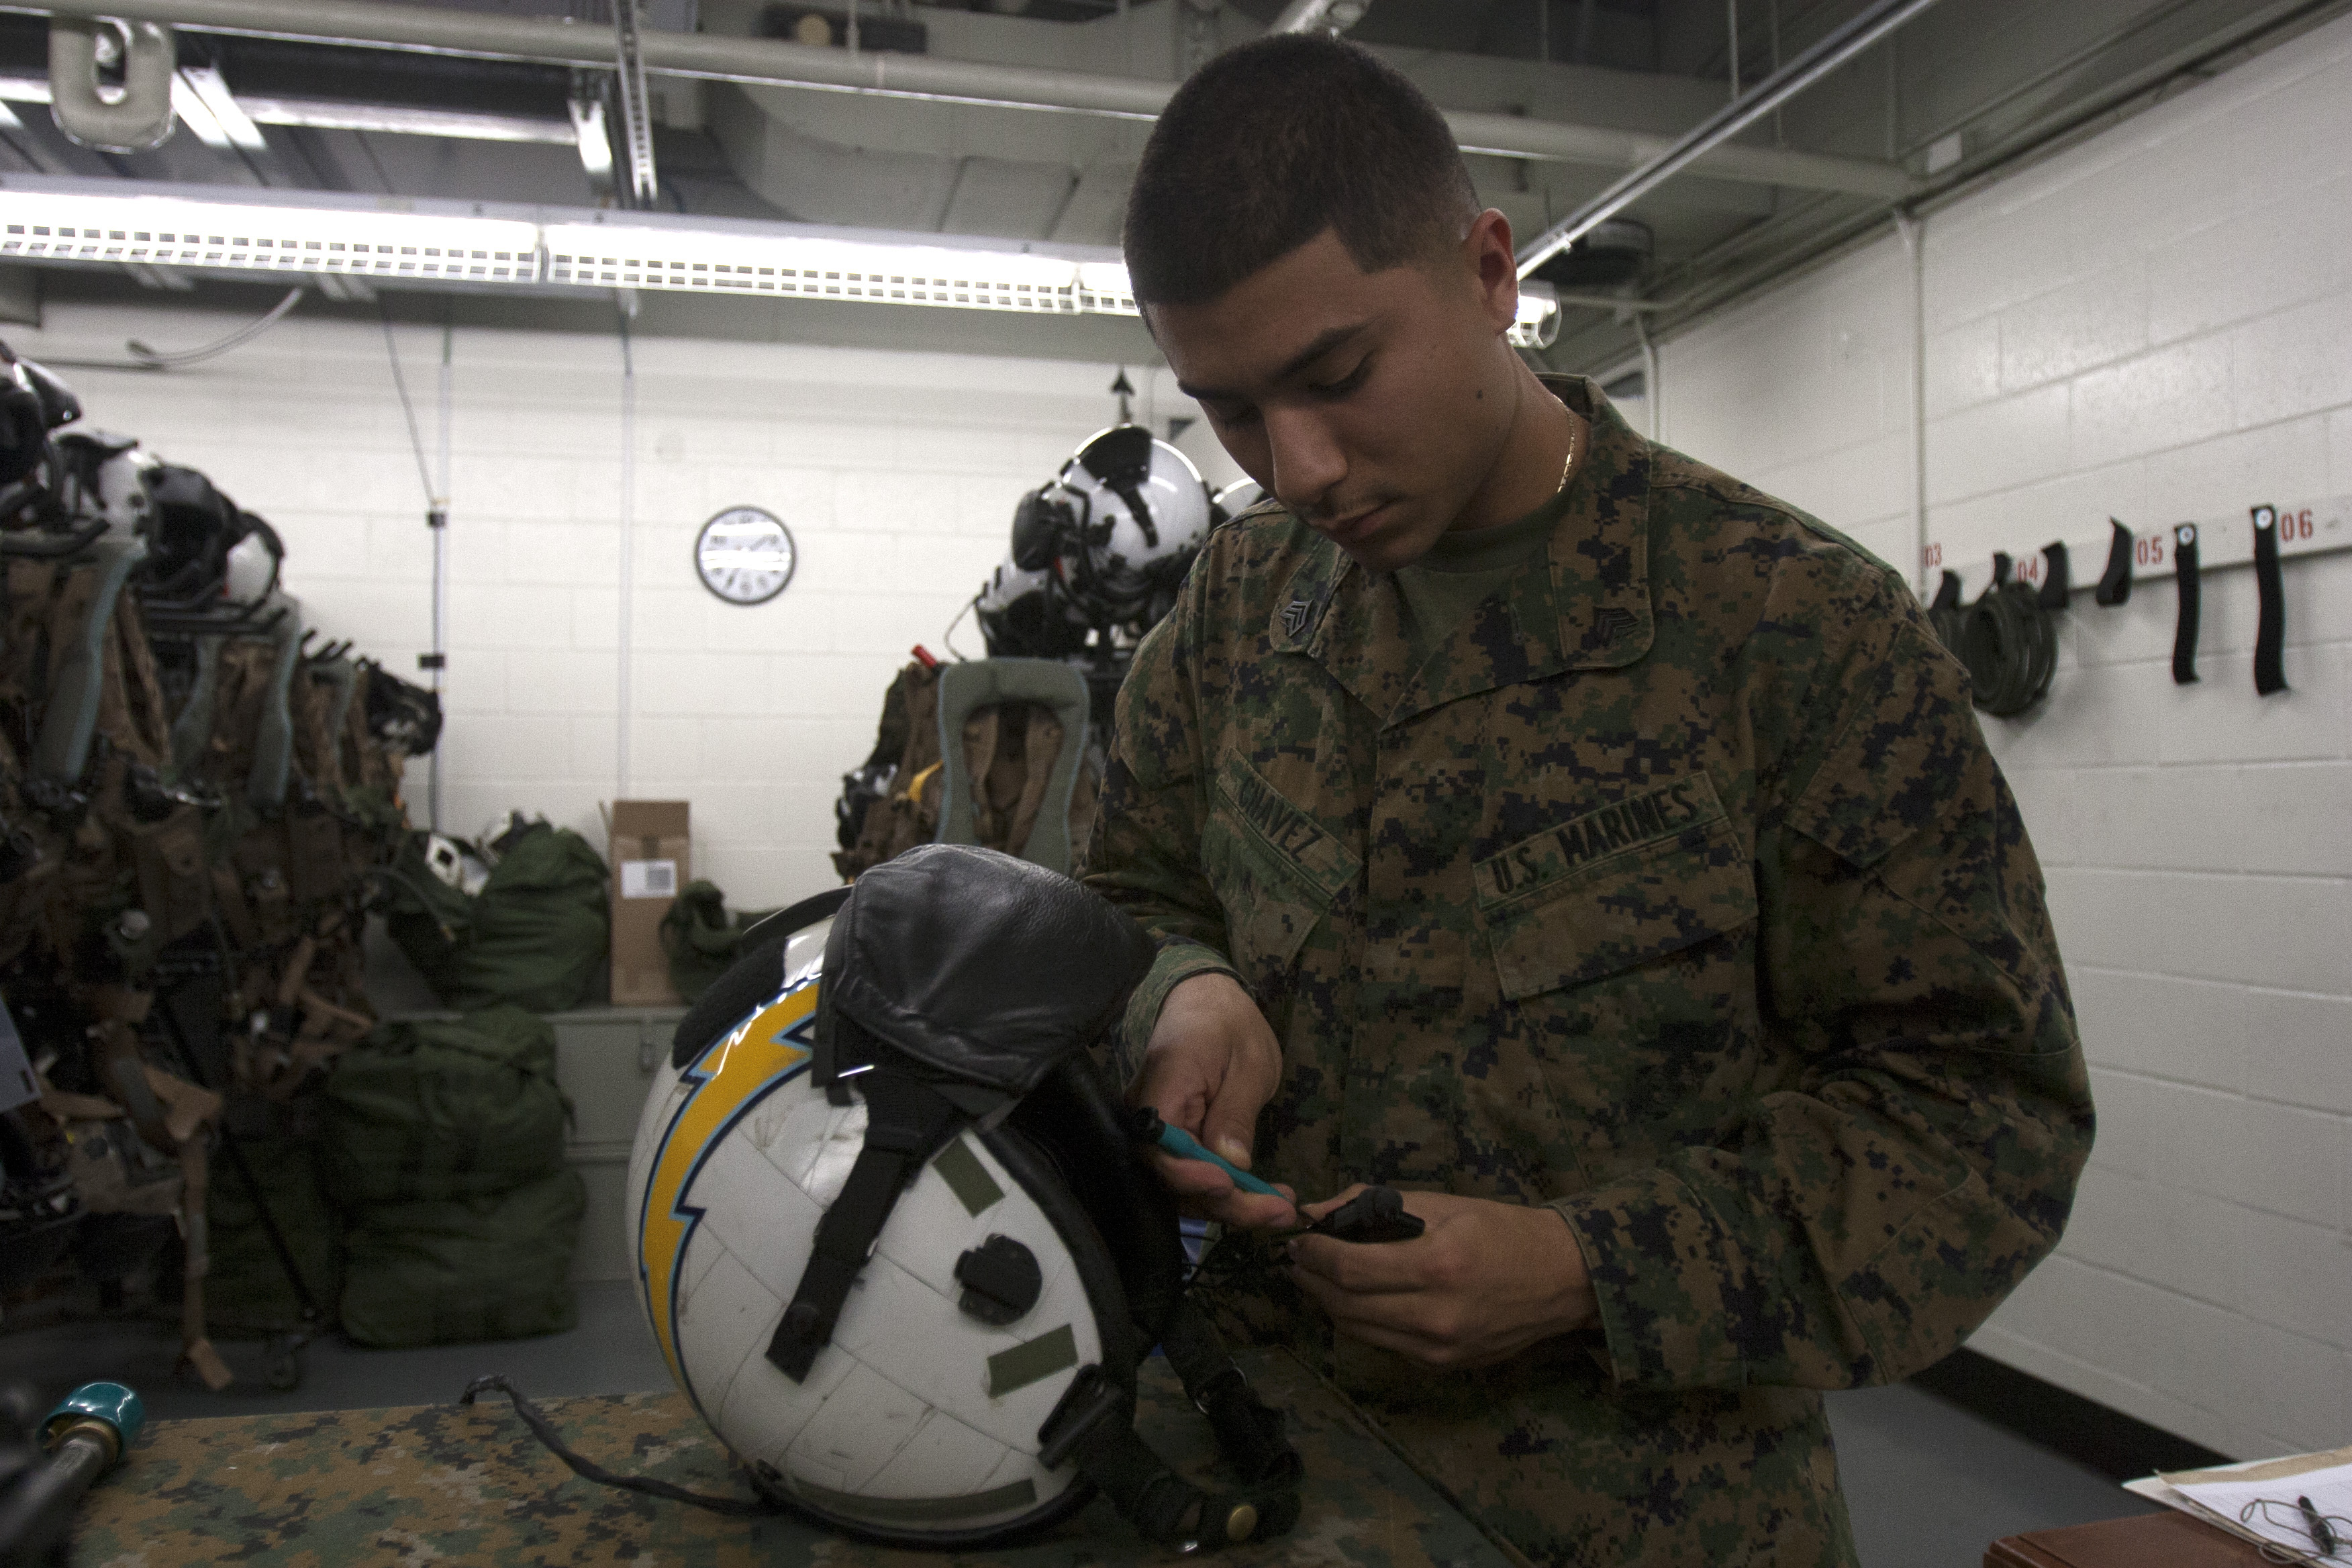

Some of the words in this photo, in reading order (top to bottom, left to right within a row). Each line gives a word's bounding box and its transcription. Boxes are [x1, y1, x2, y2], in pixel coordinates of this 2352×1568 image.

[2281, 509, 2313, 542] 06
[2135, 536, 2163, 565] 05
[2017, 556, 2038, 582] 04
[1238, 776, 1323, 863] CHAVEZ
[1556, 783, 1697, 867] MARINES
